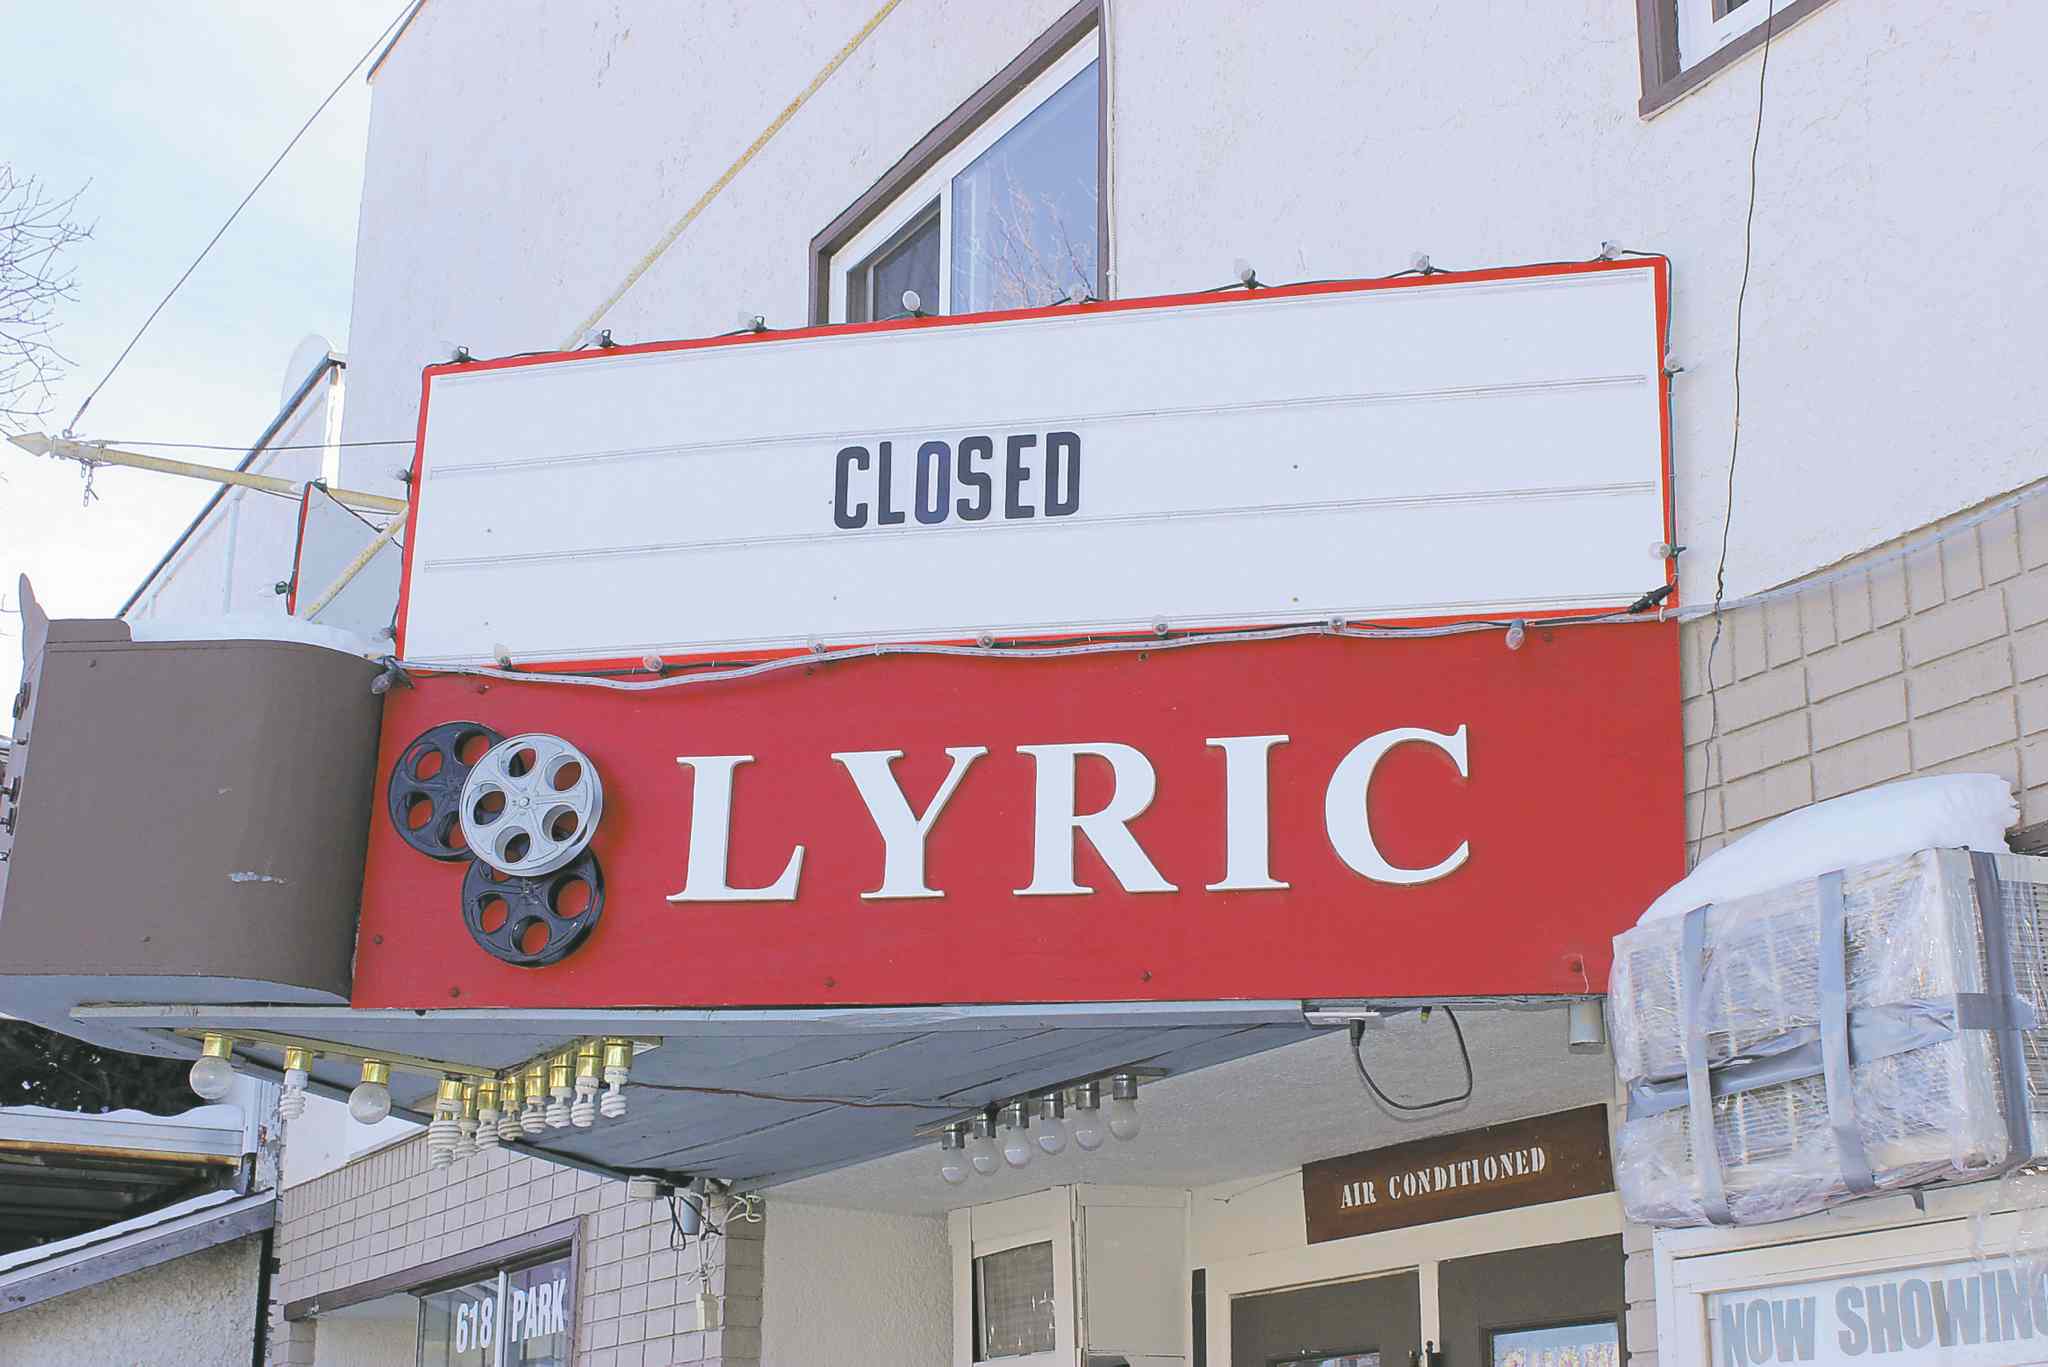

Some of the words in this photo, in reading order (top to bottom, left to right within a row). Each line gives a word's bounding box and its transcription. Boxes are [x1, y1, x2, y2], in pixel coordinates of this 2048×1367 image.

[834, 431, 1081, 529] CLOSED
[665, 724, 1470, 902] LYRIC
[1340, 1181, 1377, 1208] AIR
[1388, 1147, 1546, 1200] CONDITIONED
[456, 1297, 493, 1353] 618
[511, 1278, 567, 1342] PARK
[1721, 1296, 1816, 1367] NOW
